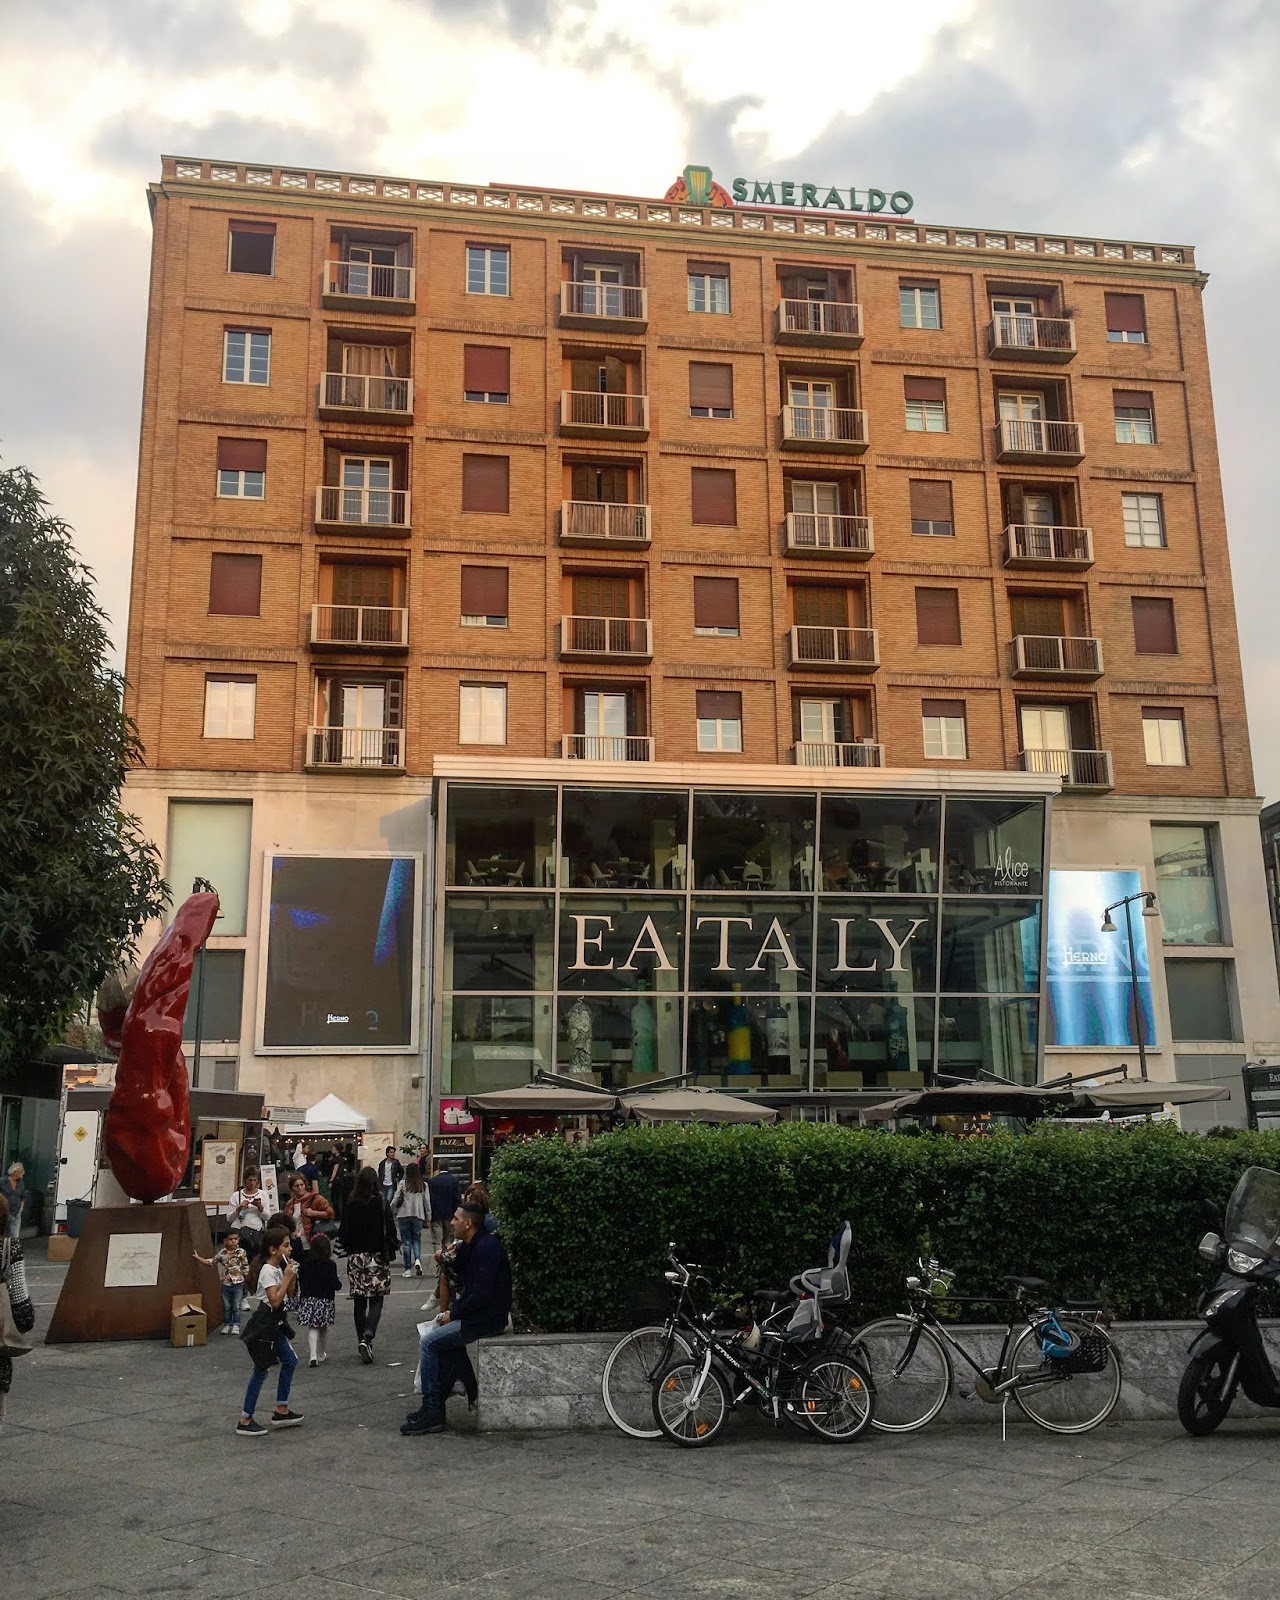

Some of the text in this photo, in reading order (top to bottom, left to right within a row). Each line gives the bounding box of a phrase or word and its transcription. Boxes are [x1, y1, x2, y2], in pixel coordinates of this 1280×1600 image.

[732, 177, 914, 214] SMERALDO
[994, 846, 1029, 881] Alice
[567, 914, 929, 972] EATALY
[1062, 946, 1107, 965] HERNO
